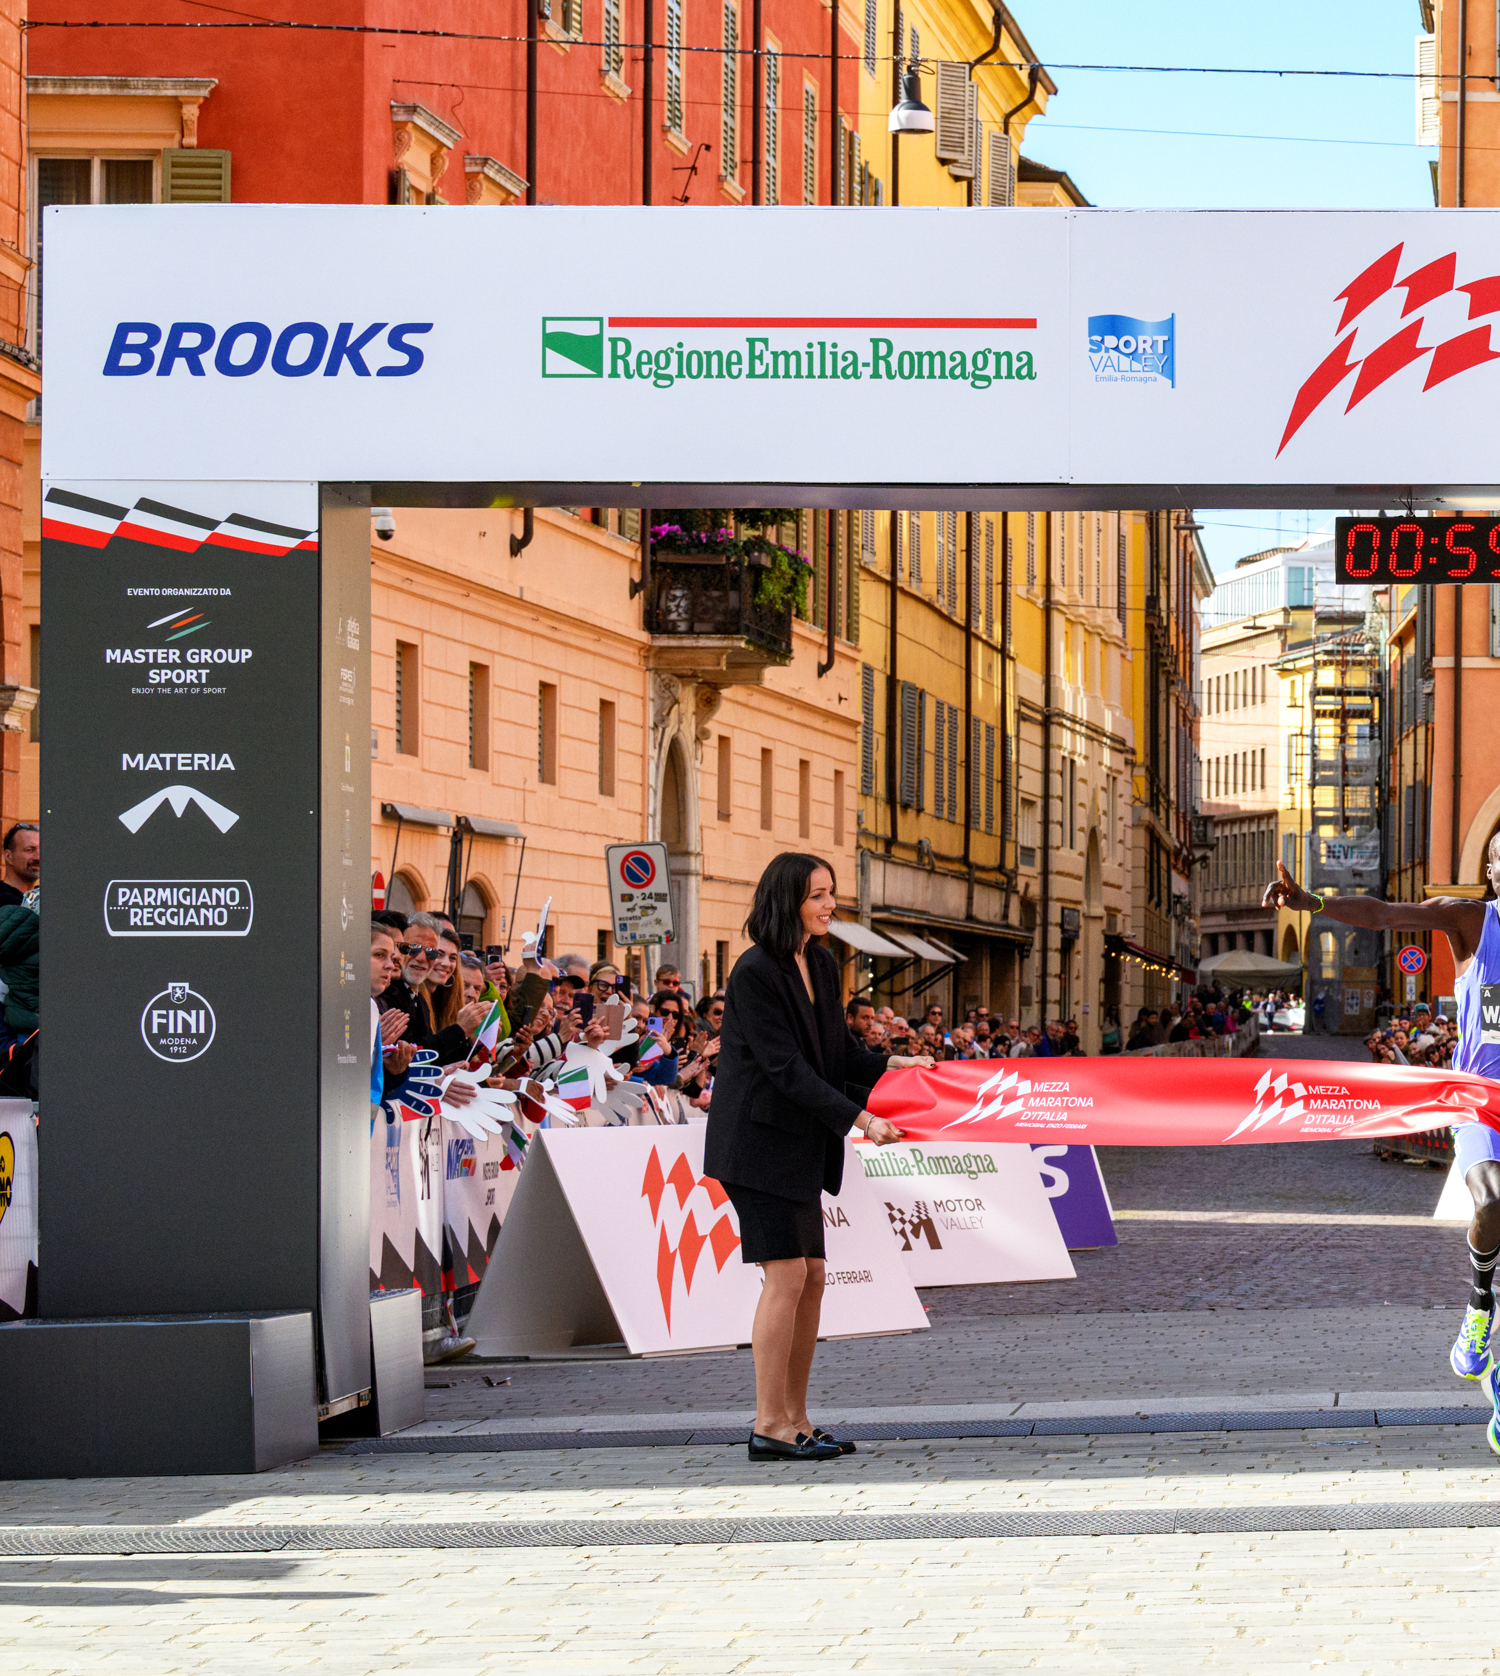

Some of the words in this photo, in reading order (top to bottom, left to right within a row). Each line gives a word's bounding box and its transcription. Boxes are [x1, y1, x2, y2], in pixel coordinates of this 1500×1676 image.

[102, 322, 433, 377] BROOKS
[1088, 335, 1168, 354] SPORT
[1088, 355, 1169, 373] VALLEY
[1095, 374, 1158, 384] Emilia-Romagna
[127, 588, 160, 596] EVENTO
[162, 588, 217, 596] ORGANIZZATO
[219, 588, 231, 596] DA
[105, 648, 182, 664] MASTER
[186, 648, 253, 664] GROUP
[148, 669, 210, 684] SPORT
[121, 753, 236, 771] MATERIA
[118, 887, 240, 906] PARMIGIANO
[129, 908, 228, 926] REGGIANO
[1484, 989, 1491, 997] A
[151, 1009, 206, 1034] FINI
[1033, 1081, 1070, 1093] MEZZA
[1308, 1085, 1349, 1096] MEZZA
[1028, 1096, 1094, 1108] MARATONA
[1310, 1098, 1381, 1110] MARATONA
[1021, 1111, 1068, 1121] D'ITALIA
[1304, 1114, 1355, 1125] D'ITALIA
[933, 1198, 985, 1213] MOTOR
[940, 1216, 985, 1230] VALLEY
[836, 1270, 874, 1284] FERRARI
